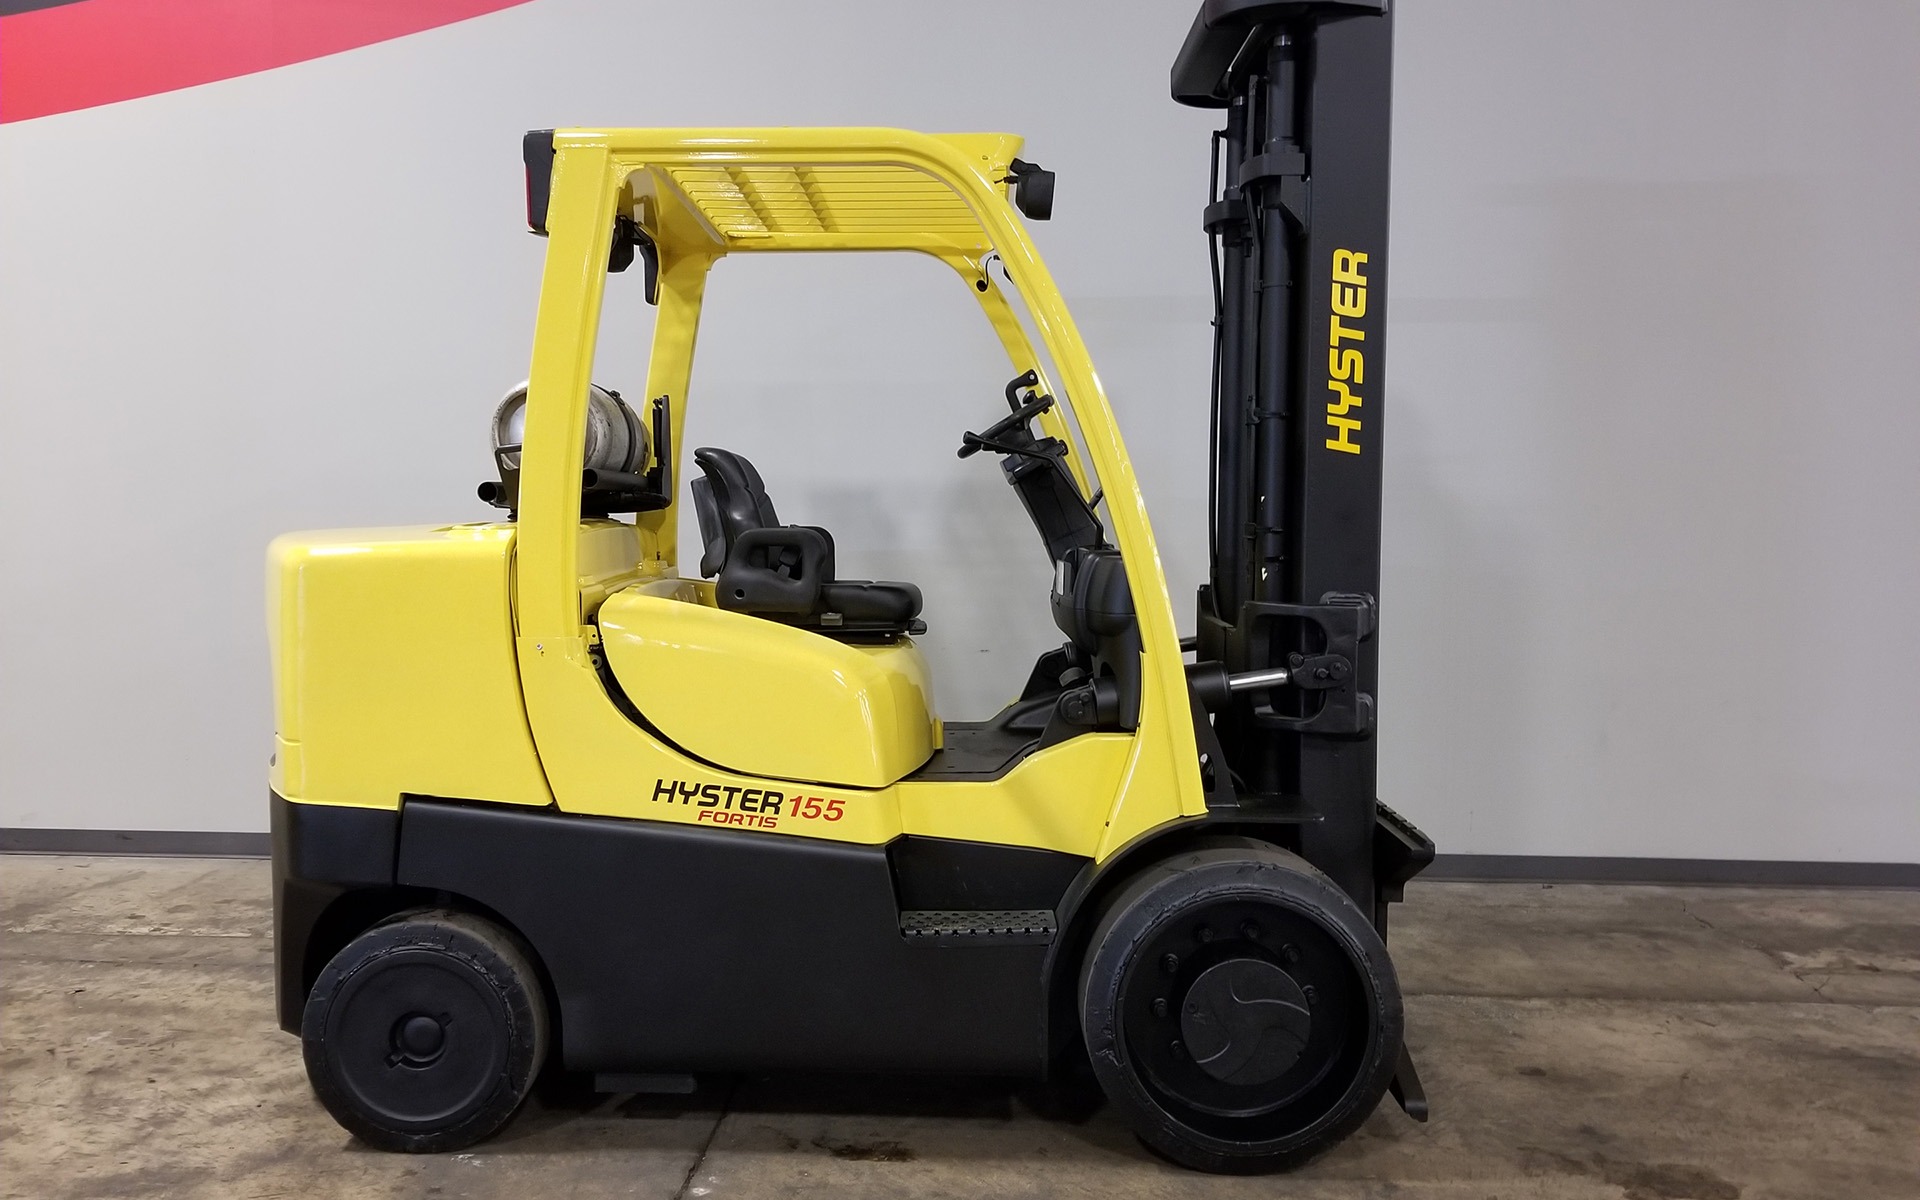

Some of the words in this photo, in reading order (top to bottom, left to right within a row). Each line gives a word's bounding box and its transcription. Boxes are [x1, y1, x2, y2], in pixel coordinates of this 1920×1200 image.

[1326, 248, 1368, 454] HYSTER
[652, 779, 784, 815] HYSTER
[789, 796, 846, 822] 155
[697, 810, 778, 829] FORTIS
